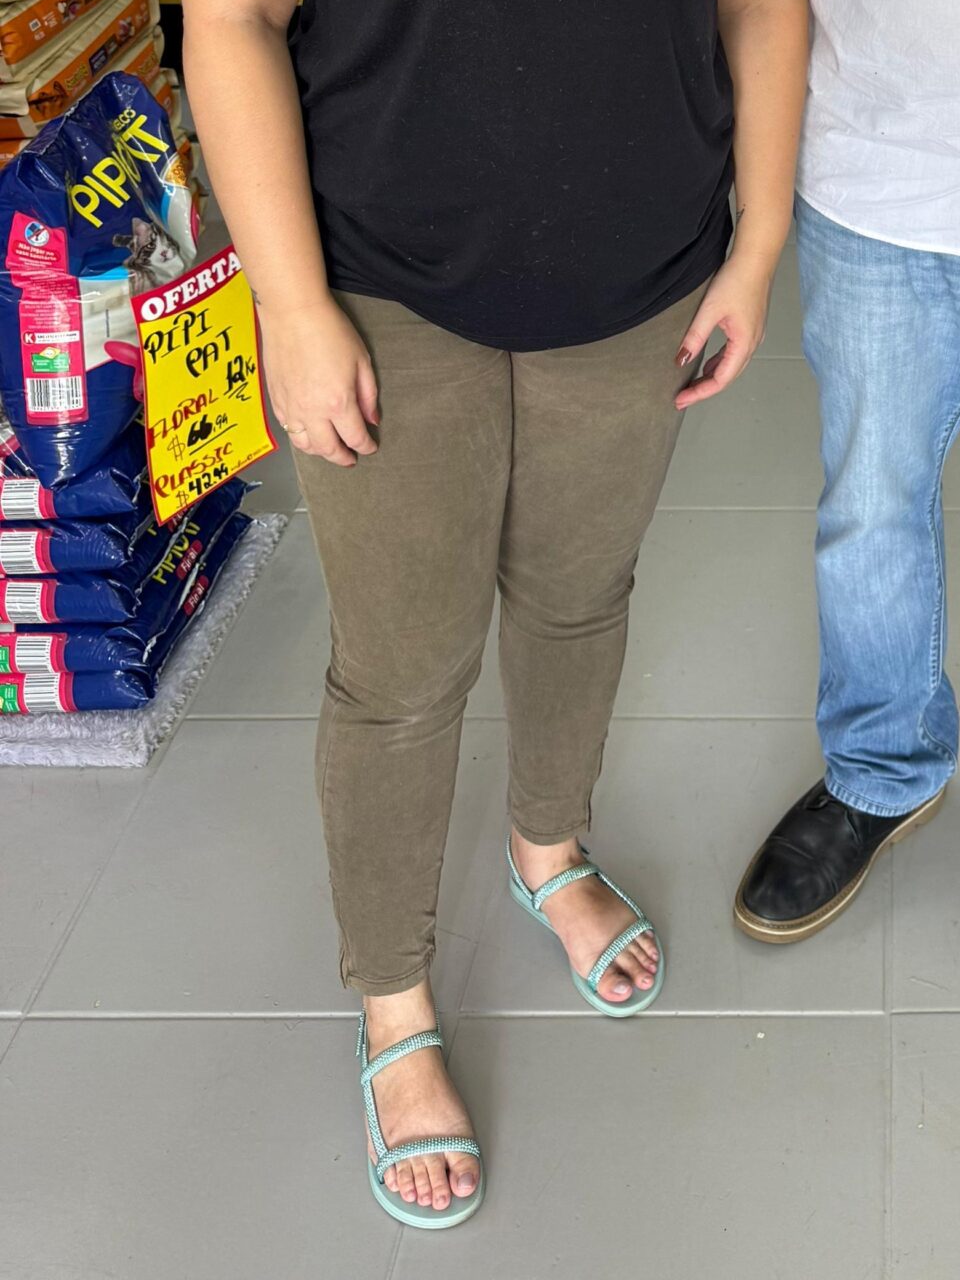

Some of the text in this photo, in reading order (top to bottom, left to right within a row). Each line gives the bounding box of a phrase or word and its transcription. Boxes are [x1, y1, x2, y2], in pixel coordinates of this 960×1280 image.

[141, 251, 242, 321] OFERTA
[143, 308, 213, 365] PIPI
[186, 326, 233, 378] PAT
